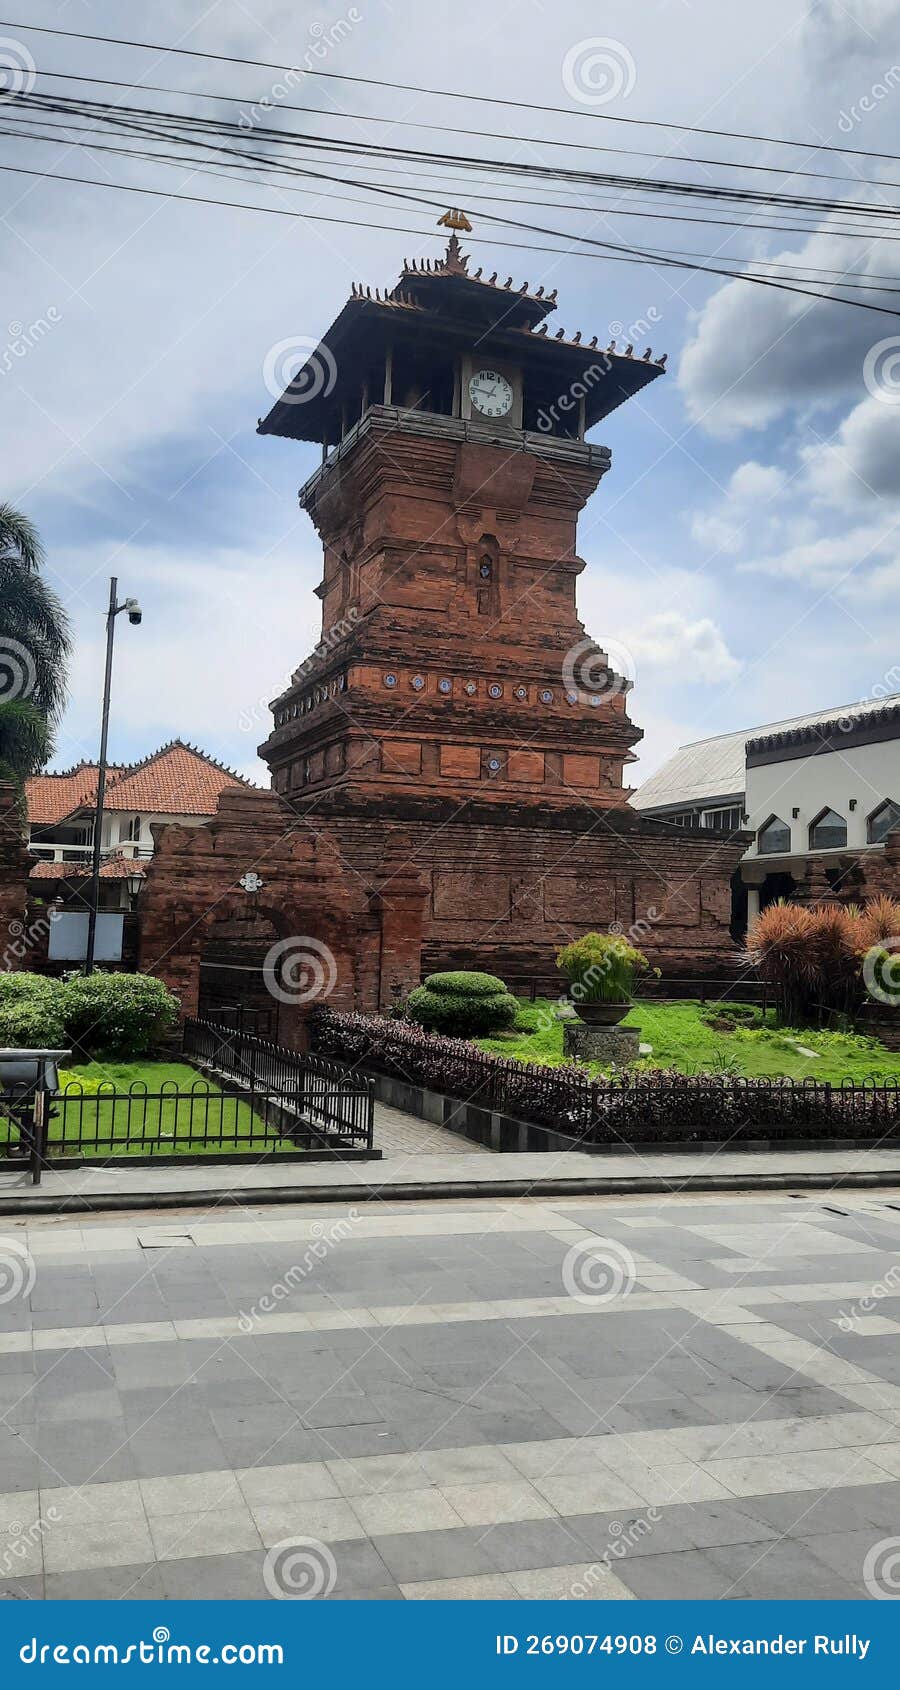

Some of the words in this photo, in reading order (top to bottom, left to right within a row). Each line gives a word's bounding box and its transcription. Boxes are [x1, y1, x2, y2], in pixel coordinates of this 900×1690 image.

[487, 372, 495, 381] 12
[503, 384, 508, 392] 2
[505, 393, 511, 402] 3
[479, 404, 485, 413] 7
[502, 402, 508, 410] 4
[487, 408, 493, 416] 6
[496, 407, 502, 415] 5
